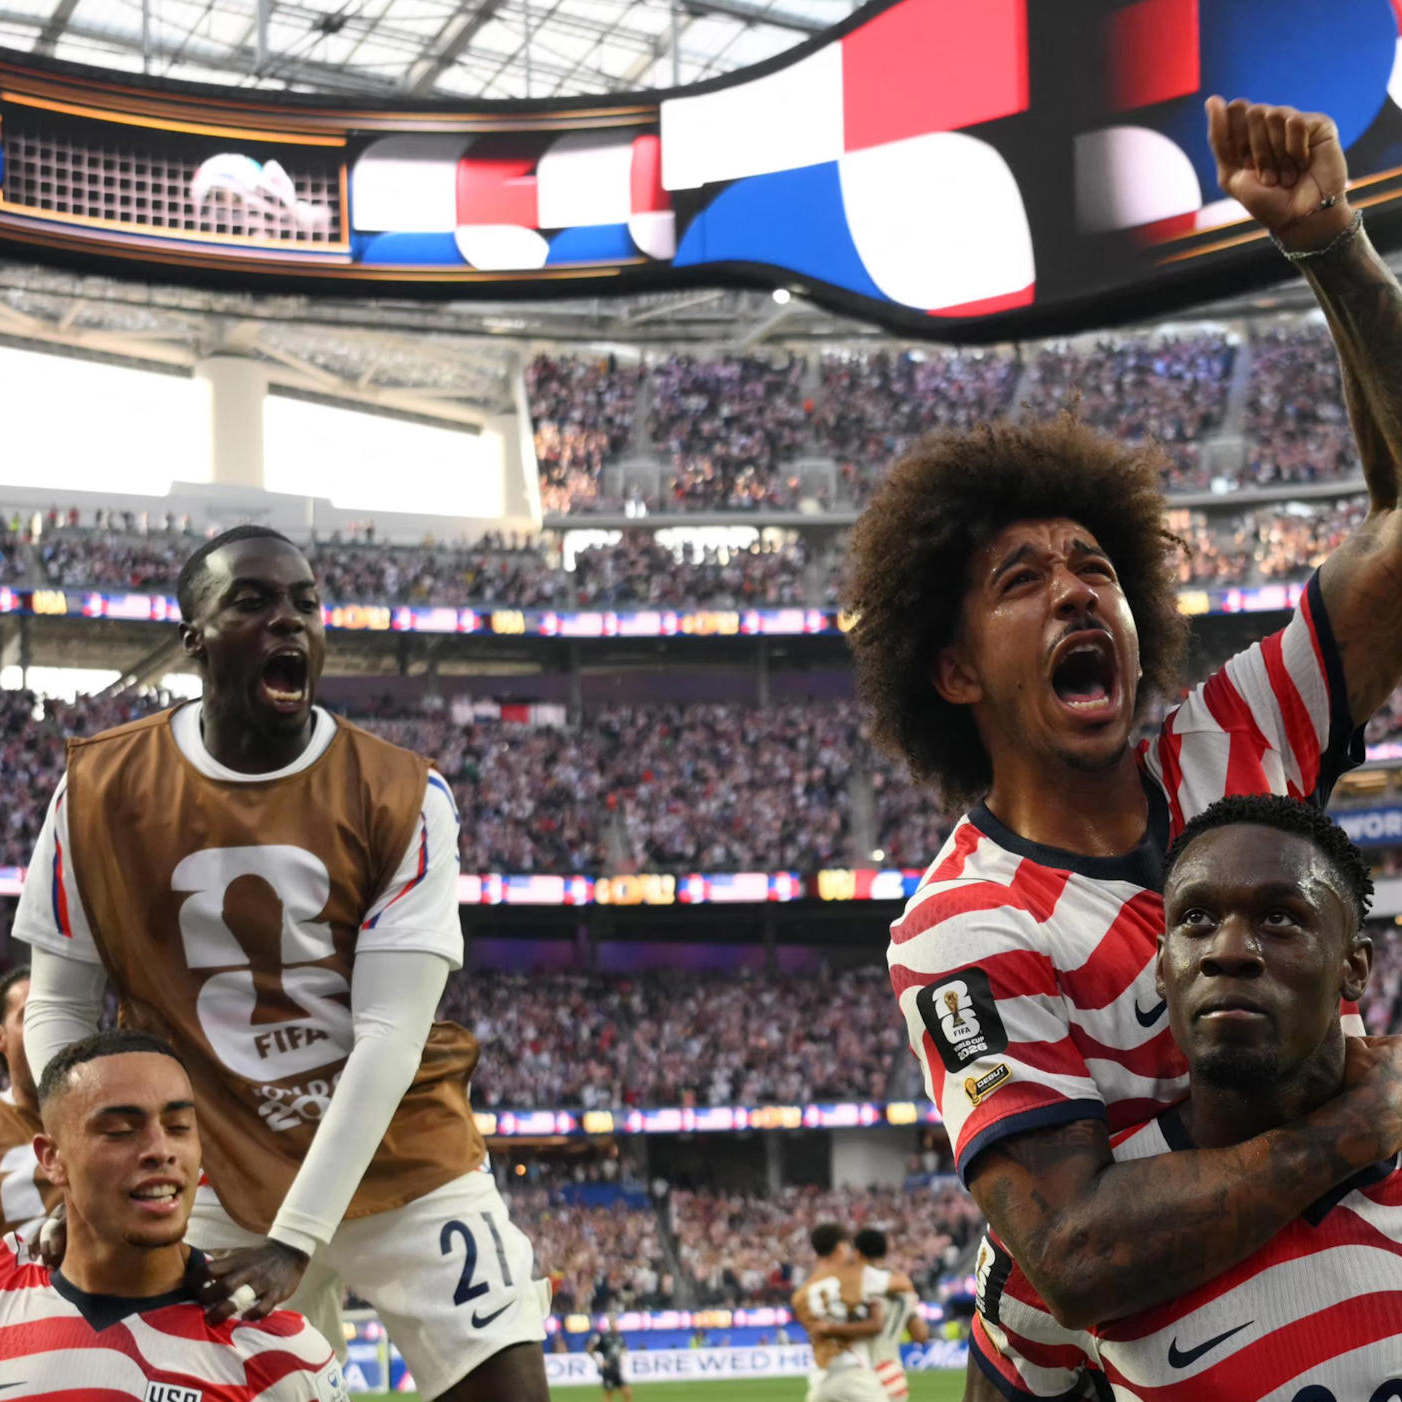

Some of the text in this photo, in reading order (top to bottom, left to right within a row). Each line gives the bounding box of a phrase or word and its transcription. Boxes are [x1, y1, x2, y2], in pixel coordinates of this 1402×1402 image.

[254, 1026, 330, 1059] FIFA
[953, 1027, 972, 1038] FIFA
[970, 1035, 985, 1046] CUP
[976, 1065, 1005, 1089] DEBUT
[439, 1211, 514, 1307] 21
[632, 1350, 771, 1374] BREWED
